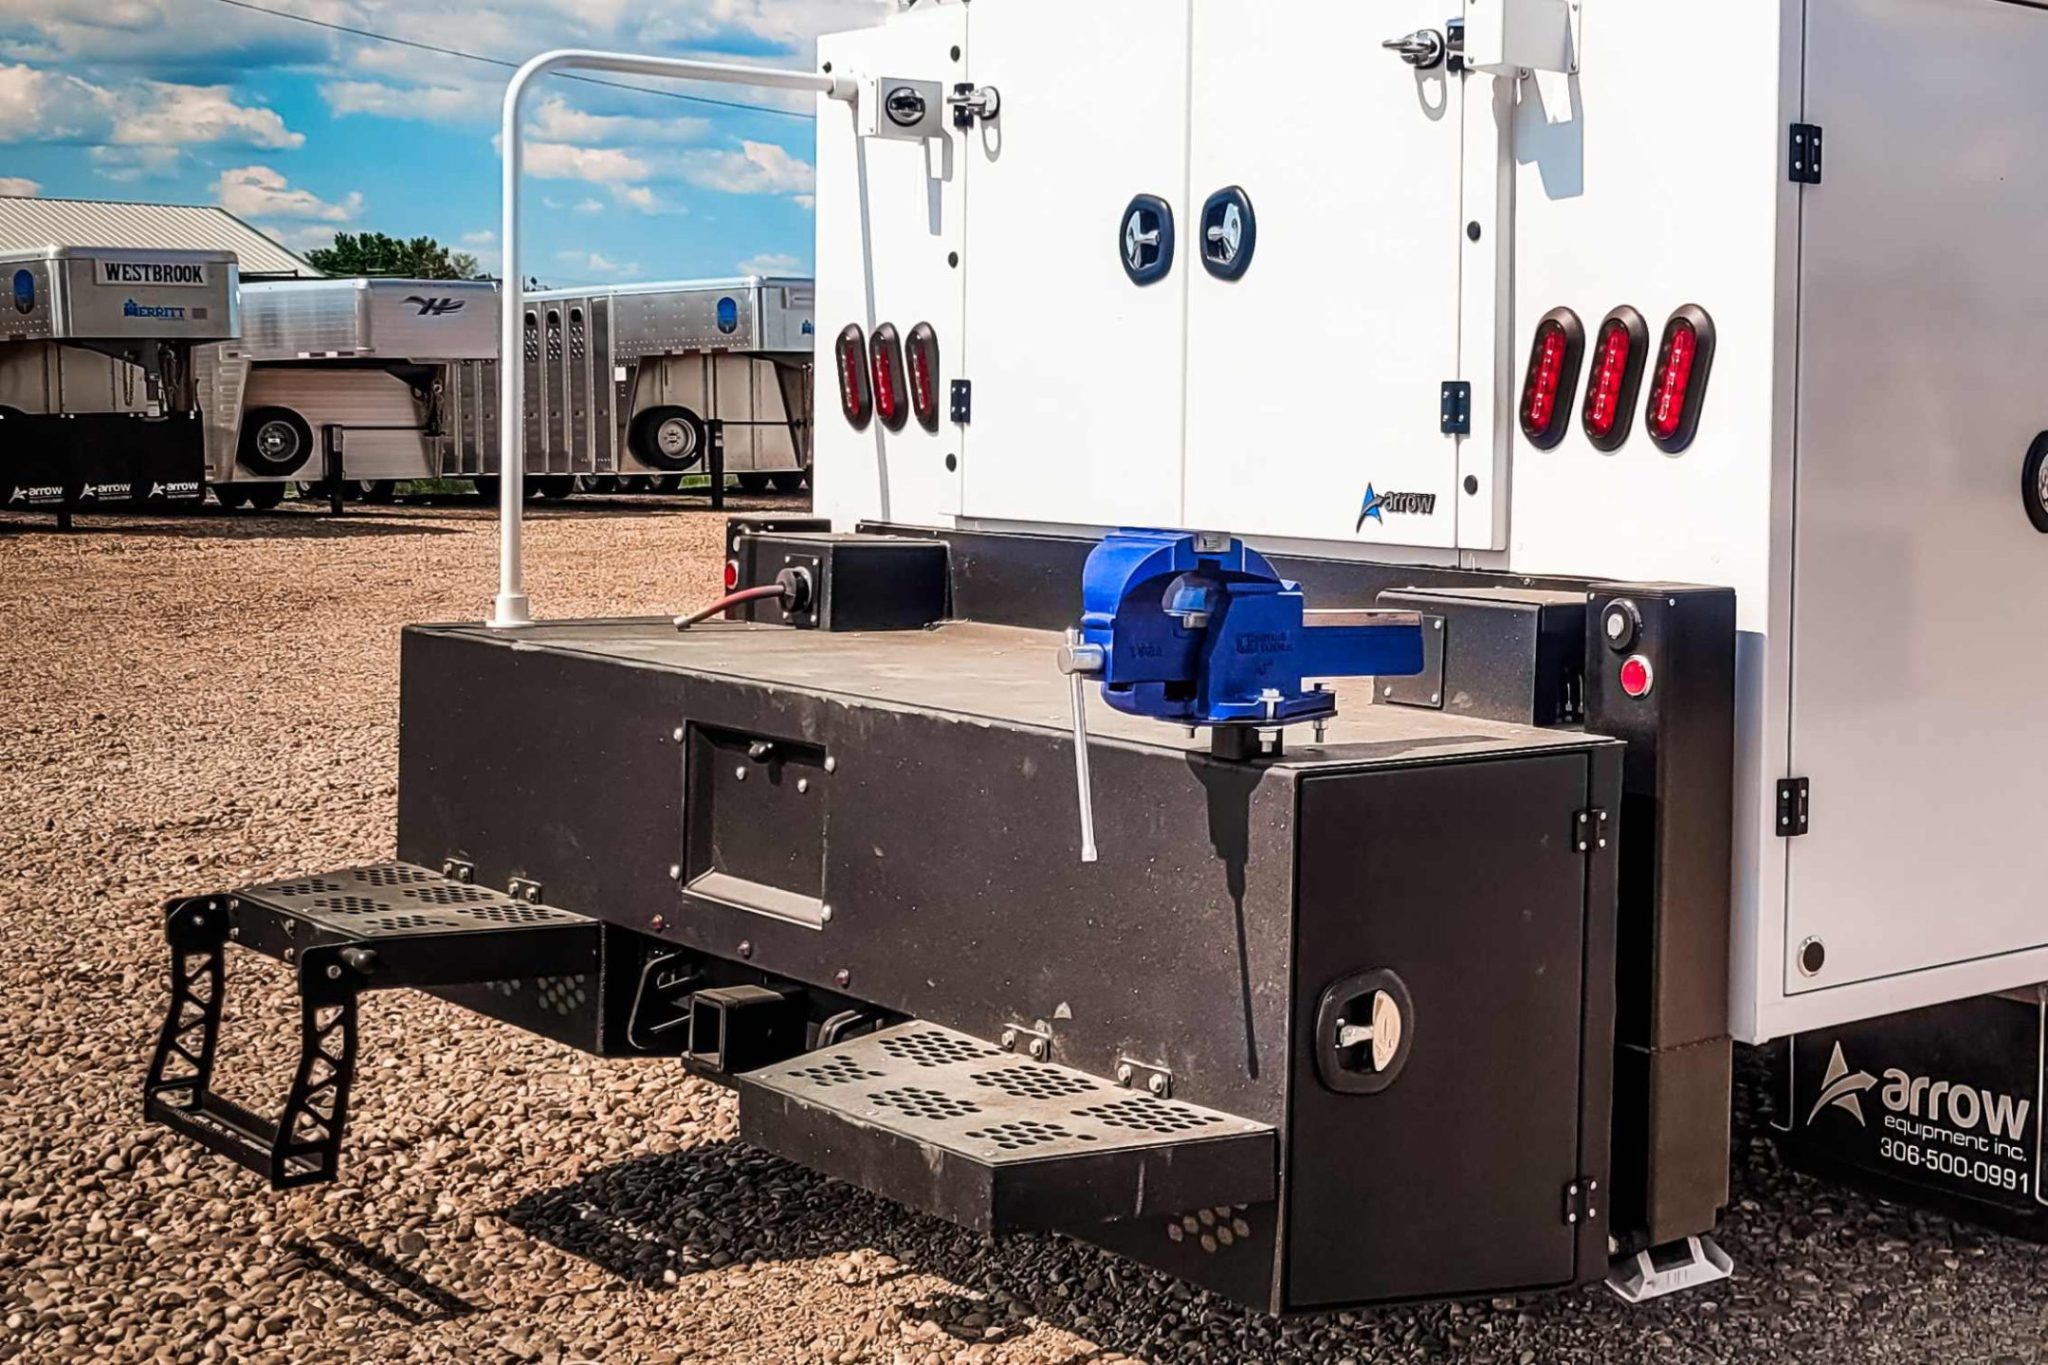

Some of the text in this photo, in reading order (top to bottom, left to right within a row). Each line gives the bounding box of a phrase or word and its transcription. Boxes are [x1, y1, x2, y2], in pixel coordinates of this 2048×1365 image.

[104, 263, 204, 283] WESTBROOK
[28, 486, 63, 496] arrow
[97, 483, 131, 493] arrow
[166, 482, 199, 492] arrow
[1384, 491, 1436, 515] arrow
[1882, 1068, 2030, 1141] arrow
[1884, 1115, 2028, 1162] equipment inc.
[1880, 1137, 2029, 1194] 306-500-0991
